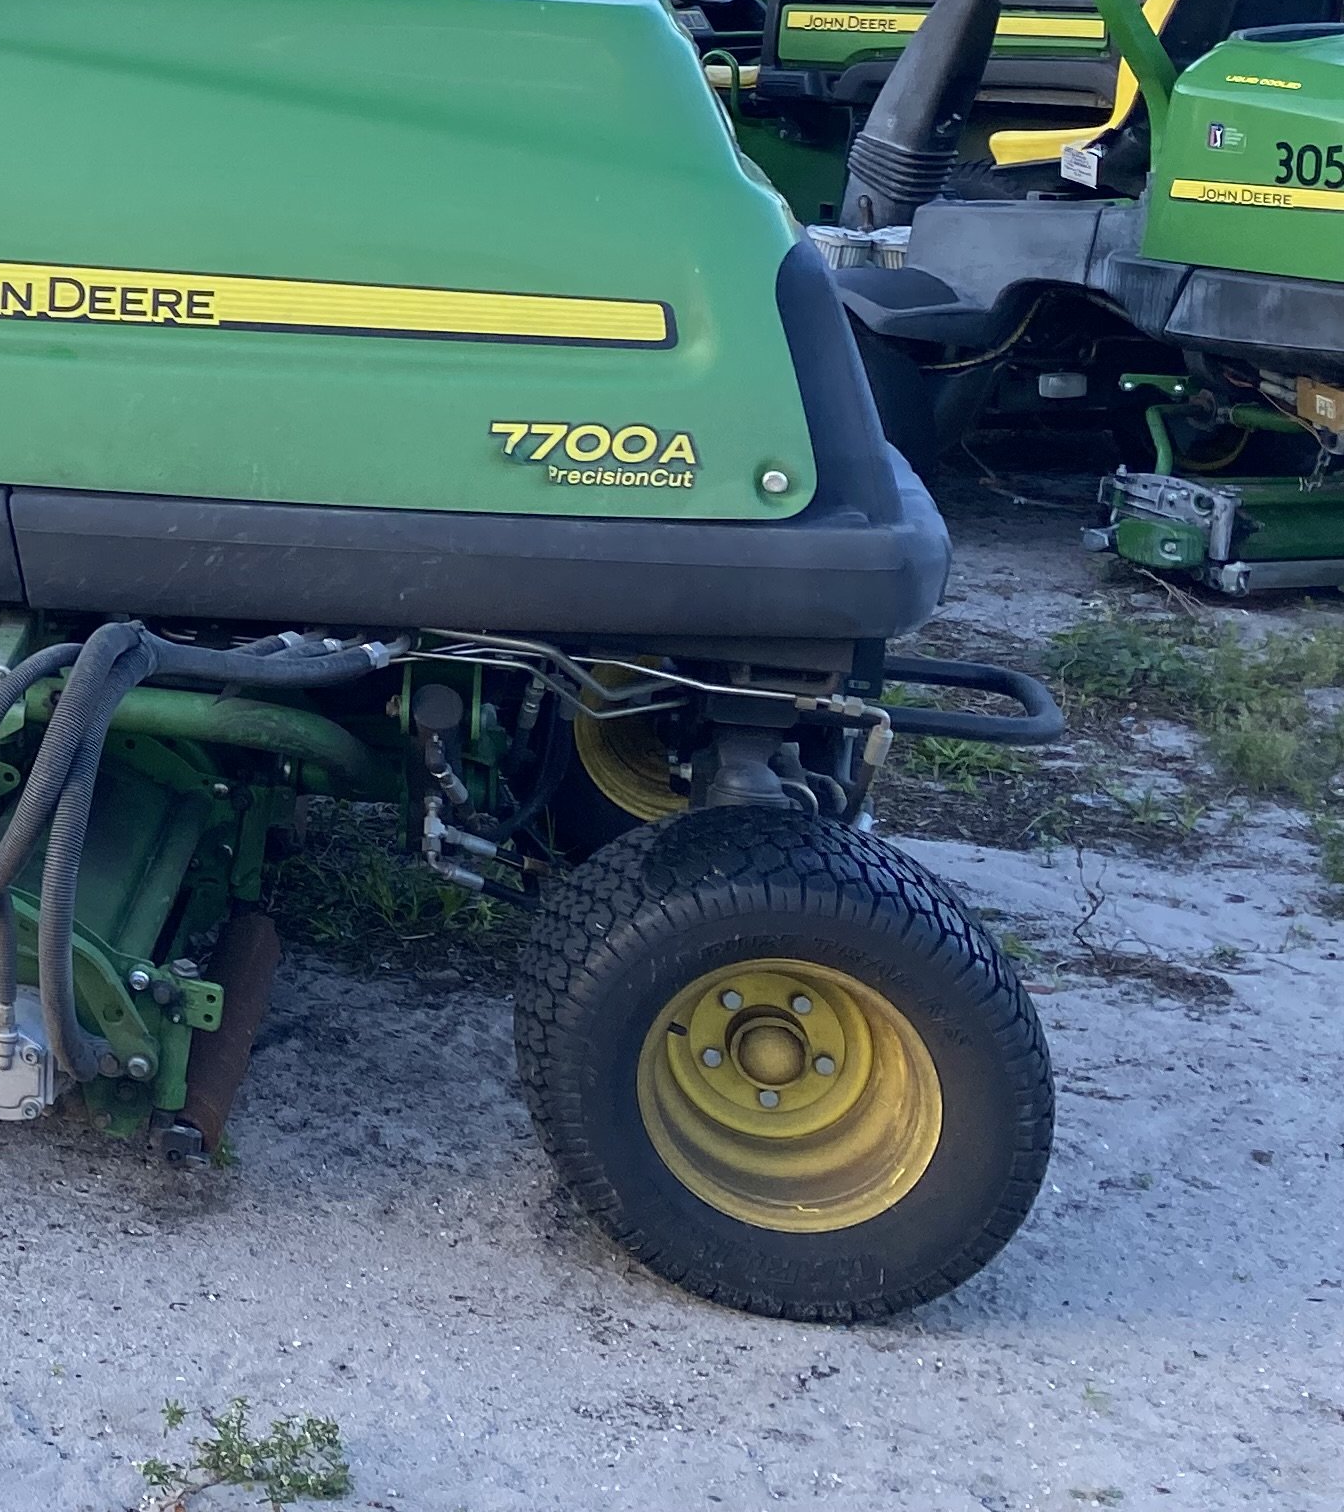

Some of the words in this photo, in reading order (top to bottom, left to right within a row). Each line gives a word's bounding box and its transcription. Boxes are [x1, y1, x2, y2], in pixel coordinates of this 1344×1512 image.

[804, 14, 844, 29] JOHN
[847, 15, 898, 30] DEERE
[1275, 141, 1344, 189] 305
[1198, 185, 1238, 202] JOHN
[1241, 189, 1293, 206] DEERE
[48, 276, 216, 320] DEERE
[489, 421, 697, 466] 7700A
